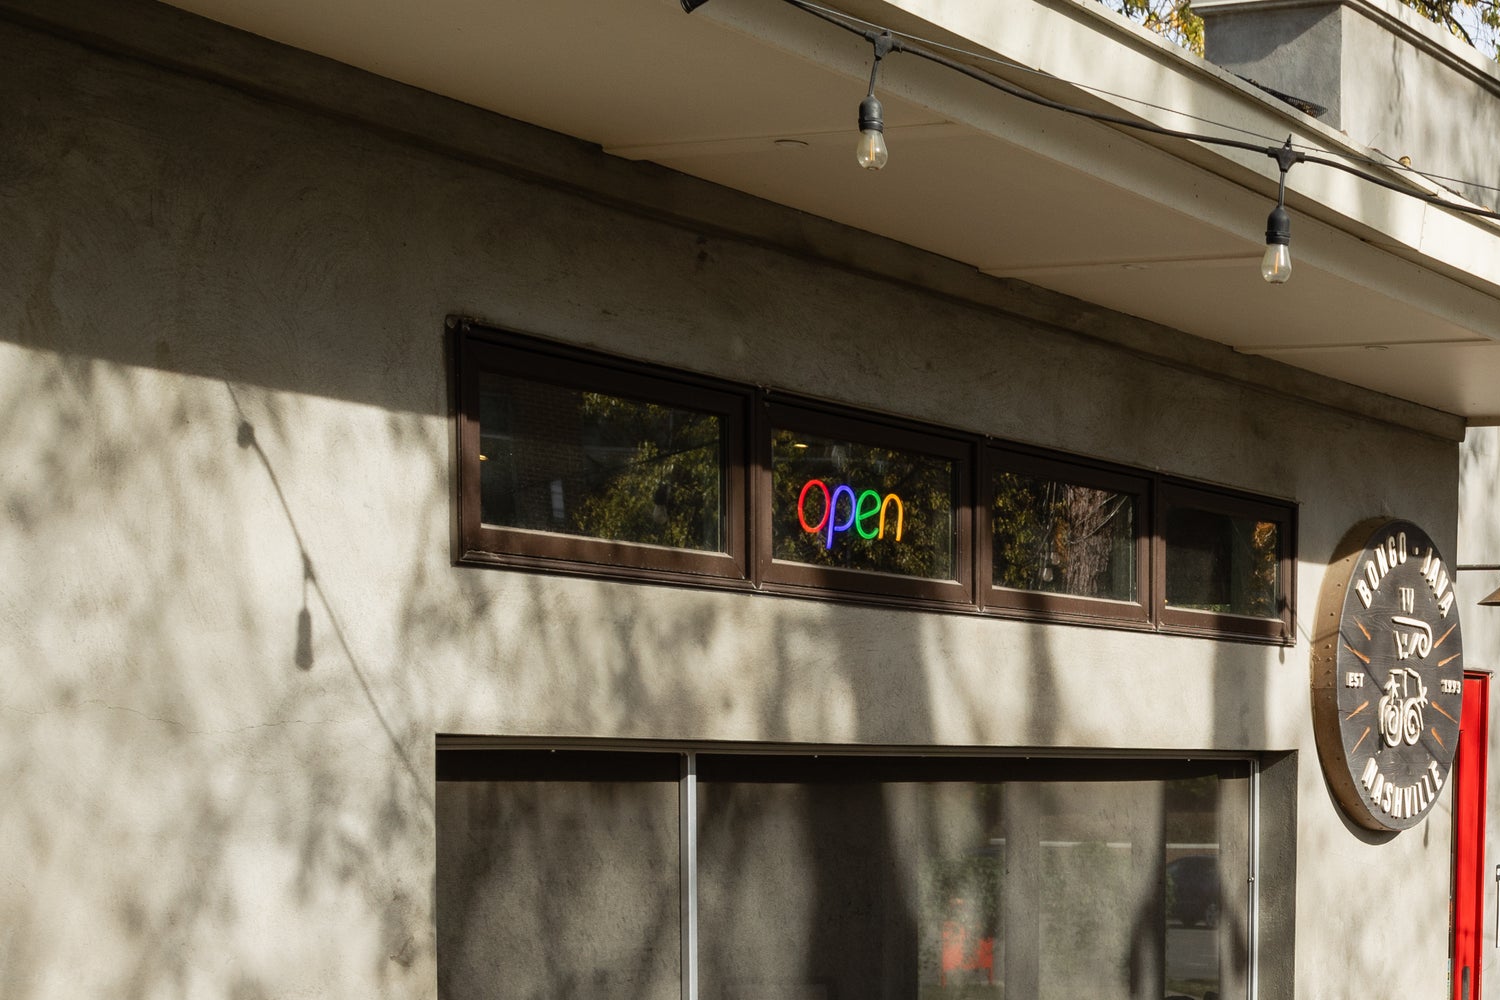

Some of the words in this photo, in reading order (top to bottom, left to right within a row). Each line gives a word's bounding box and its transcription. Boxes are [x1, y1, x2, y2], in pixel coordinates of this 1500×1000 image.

[1356, 532, 1407, 609] BONGO
[1420, 547, 1454, 619] JAVA
[1346, 672, 1365, 688] EST
[1441, 679, 1461, 694] 1993
[1361, 757, 1443, 820] NASHVILLE
